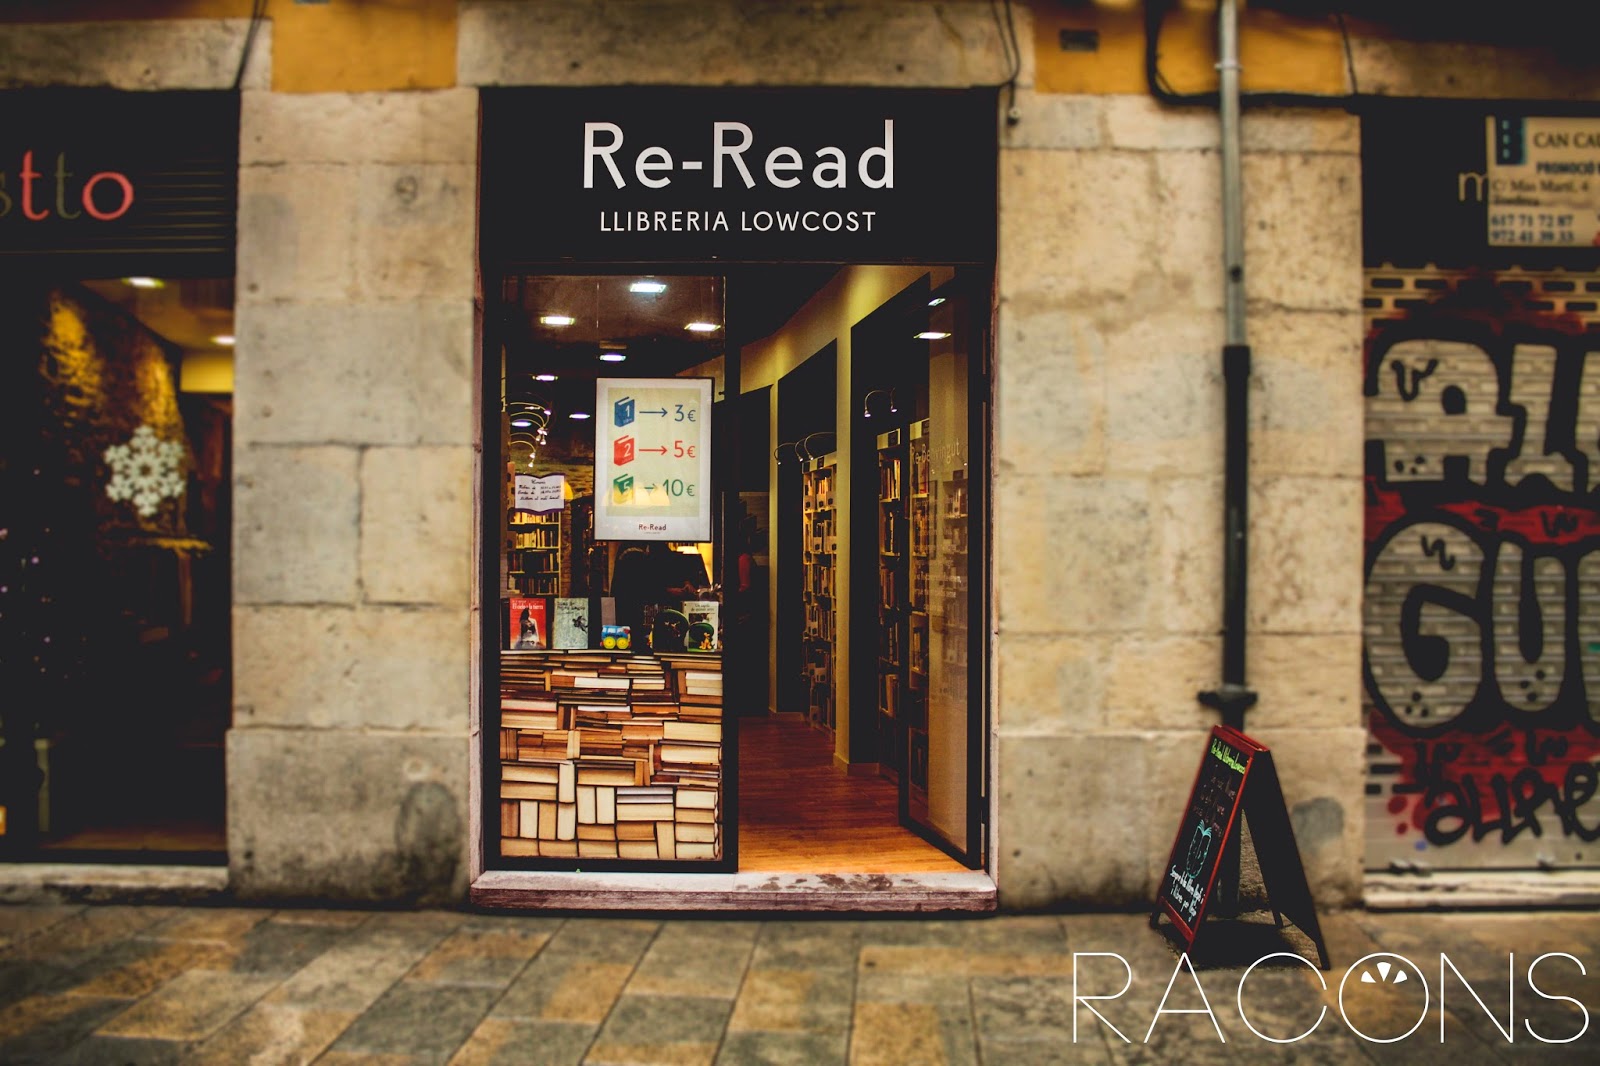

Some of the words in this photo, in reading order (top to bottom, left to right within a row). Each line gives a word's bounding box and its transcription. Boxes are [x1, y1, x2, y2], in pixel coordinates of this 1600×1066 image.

[1533, 132, 1569, 149] CAN
[583, 119, 894, 190] Re-Read
[599, 210, 729, 232] LLIBRERIA
[740, 210, 876, 232] LOWCOST
[638, 523, 667, 531] Re-Read
